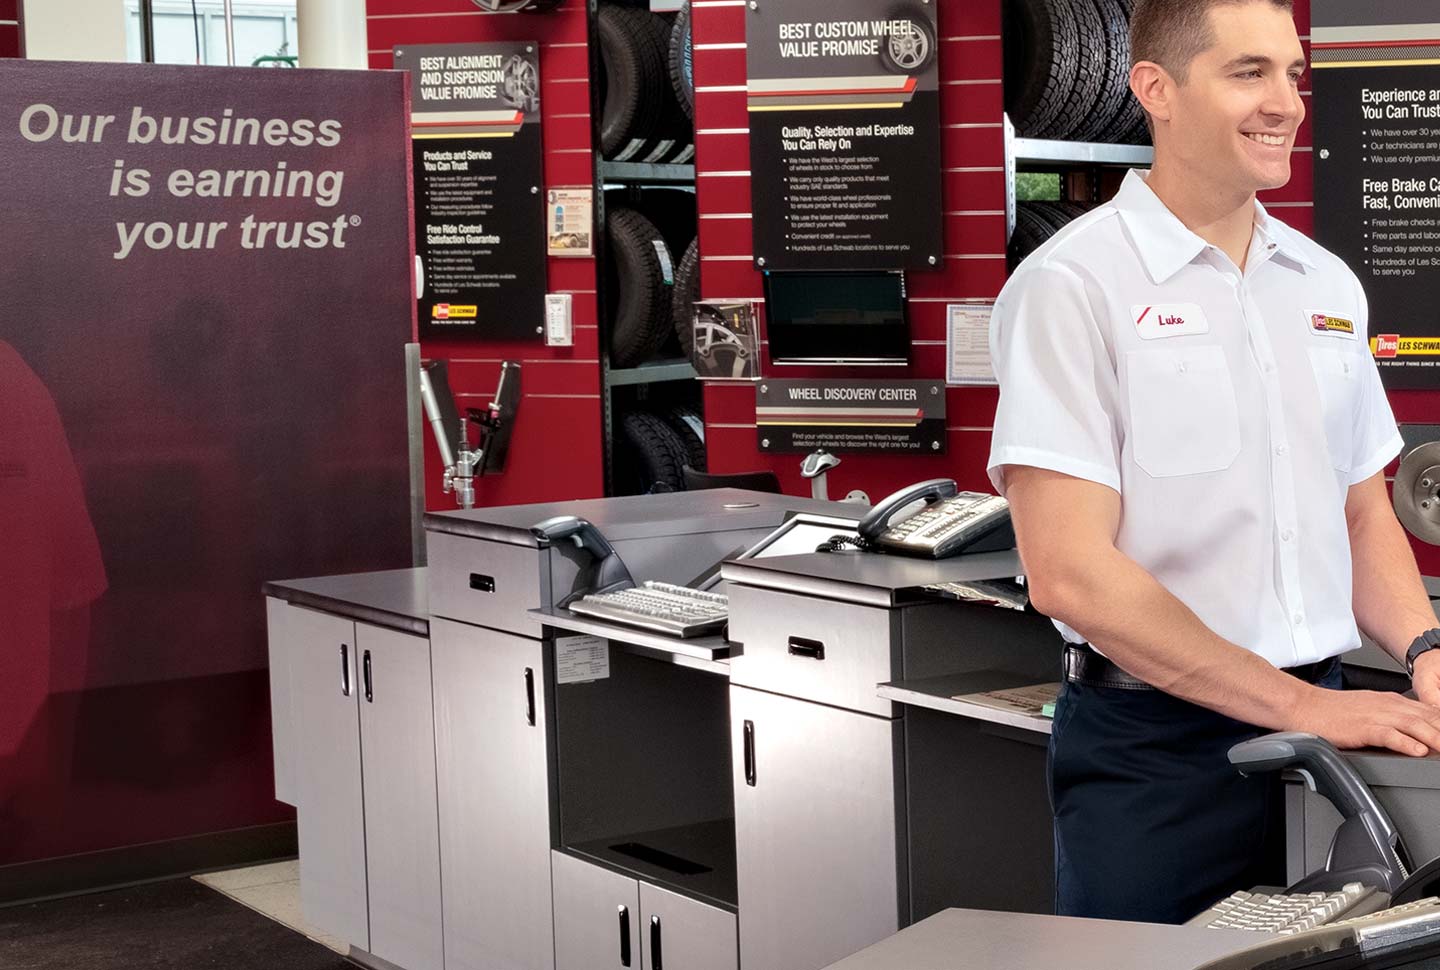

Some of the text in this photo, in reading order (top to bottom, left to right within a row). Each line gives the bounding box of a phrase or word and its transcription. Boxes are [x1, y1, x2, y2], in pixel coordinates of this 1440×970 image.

[779, 20, 915, 39] BEST CUSTOM WHEEL
[780, 40, 878, 57] VALUE PROMISE
[420, 55, 502, 70] BEST ALIGNMENT
[420, 71, 504, 85] AND SUSPENSION
[421, 85, 496, 100] VALUE PROMISE
[1362, 88, 1425, 104] Experience
[1362, 104, 1440, 119] You Can Trust
[19, 103, 343, 146] Our business
[782, 125, 914, 139] Quality, Selection and Expertise
[782, 138, 851, 151] You Can Rely On
[1371, 142, 1383, 150] Our
[1371, 155, 1382, 163] We
[1399, 155, 1413, 164] only
[109, 159, 344, 207] is earning
[1363, 179, 1388, 192] Free
[1392, 178, 1425, 192] Brake
[1364, 195, 1391, 210] Fast,
[113, 221, 227, 260] your
[1389, 232, 1407, 240] parts
[1394, 245, 1407, 253] day
[1373, 258, 1406, 266] Hundreds
[1158, 315, 1184, 325] Luke
[1377, 337, 1397, 351] Tires
[1399, 341, 1411, 350] LES
[789, 388, 916, 400] WHEEL DISCOVERY CENTER
